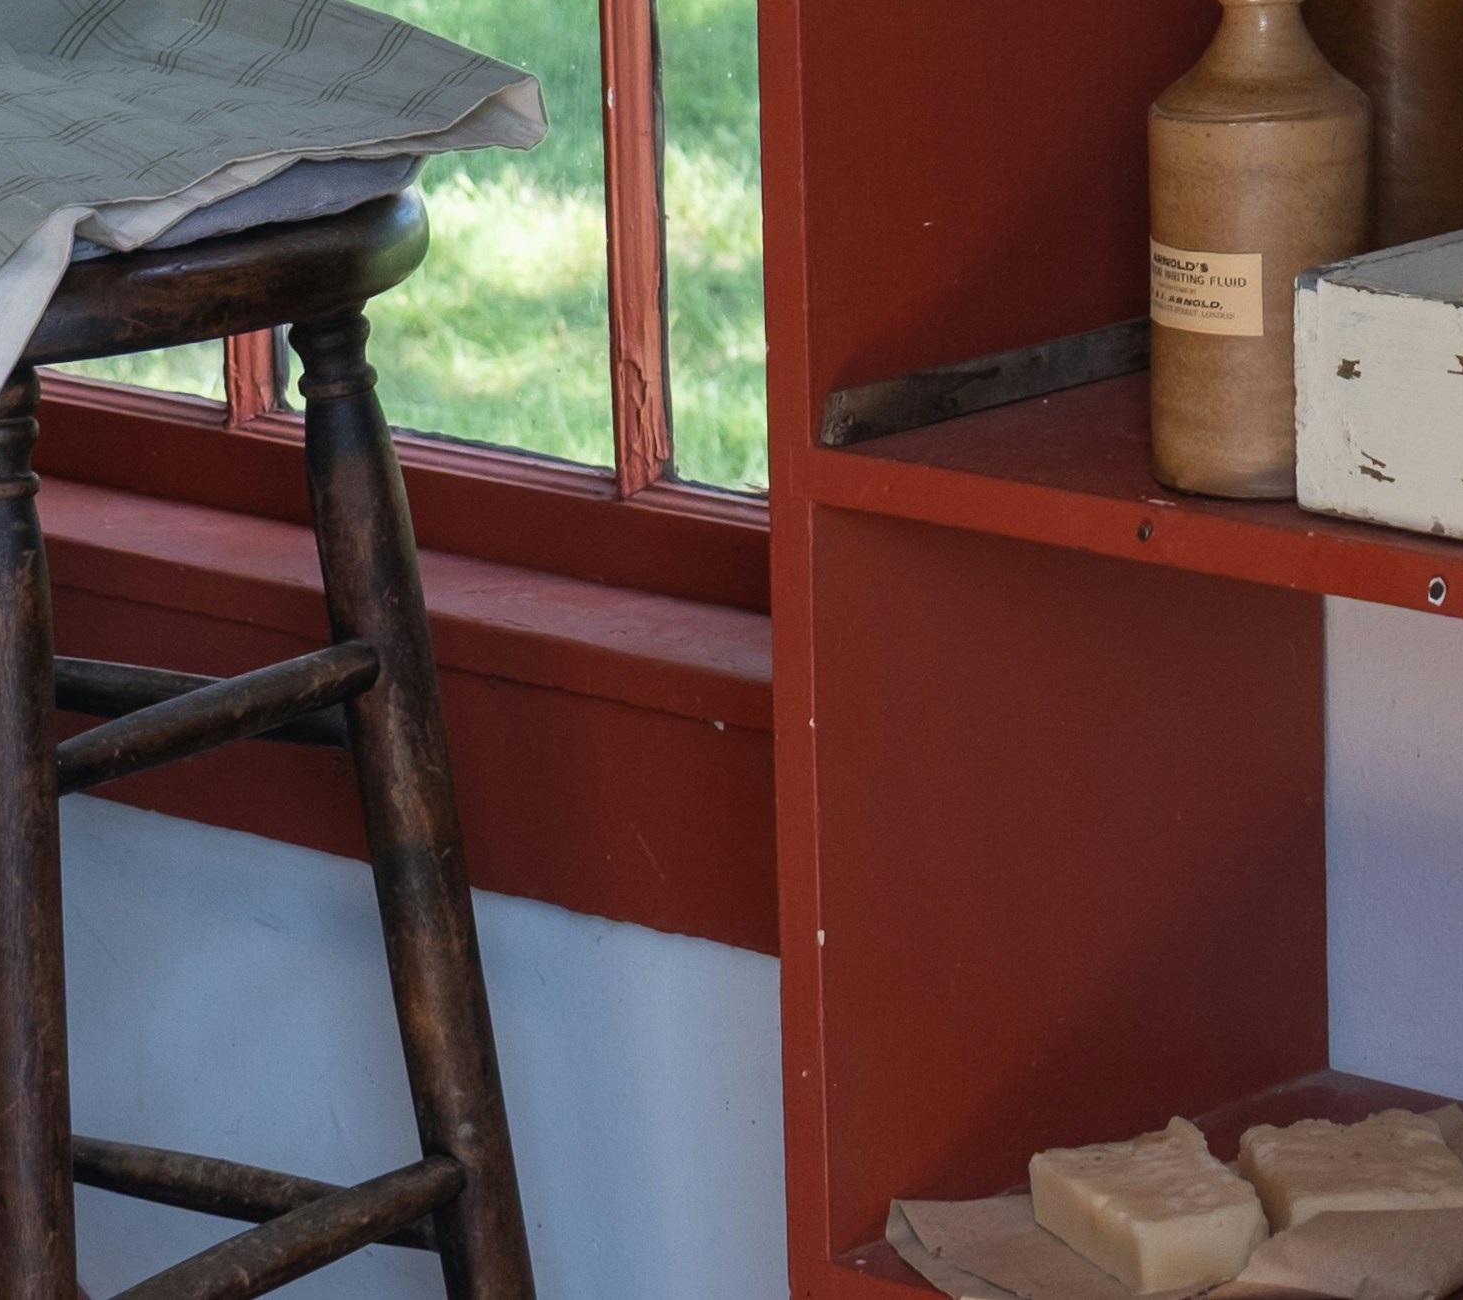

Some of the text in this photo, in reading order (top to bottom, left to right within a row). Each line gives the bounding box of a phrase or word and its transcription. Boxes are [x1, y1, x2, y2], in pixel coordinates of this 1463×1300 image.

[1153, 252, 1208, 273] ARNOLD'S
[1164, 270, 1247, 288] WRITING FLUID
[1168, 295, 1223, 311] ARNOLD,
